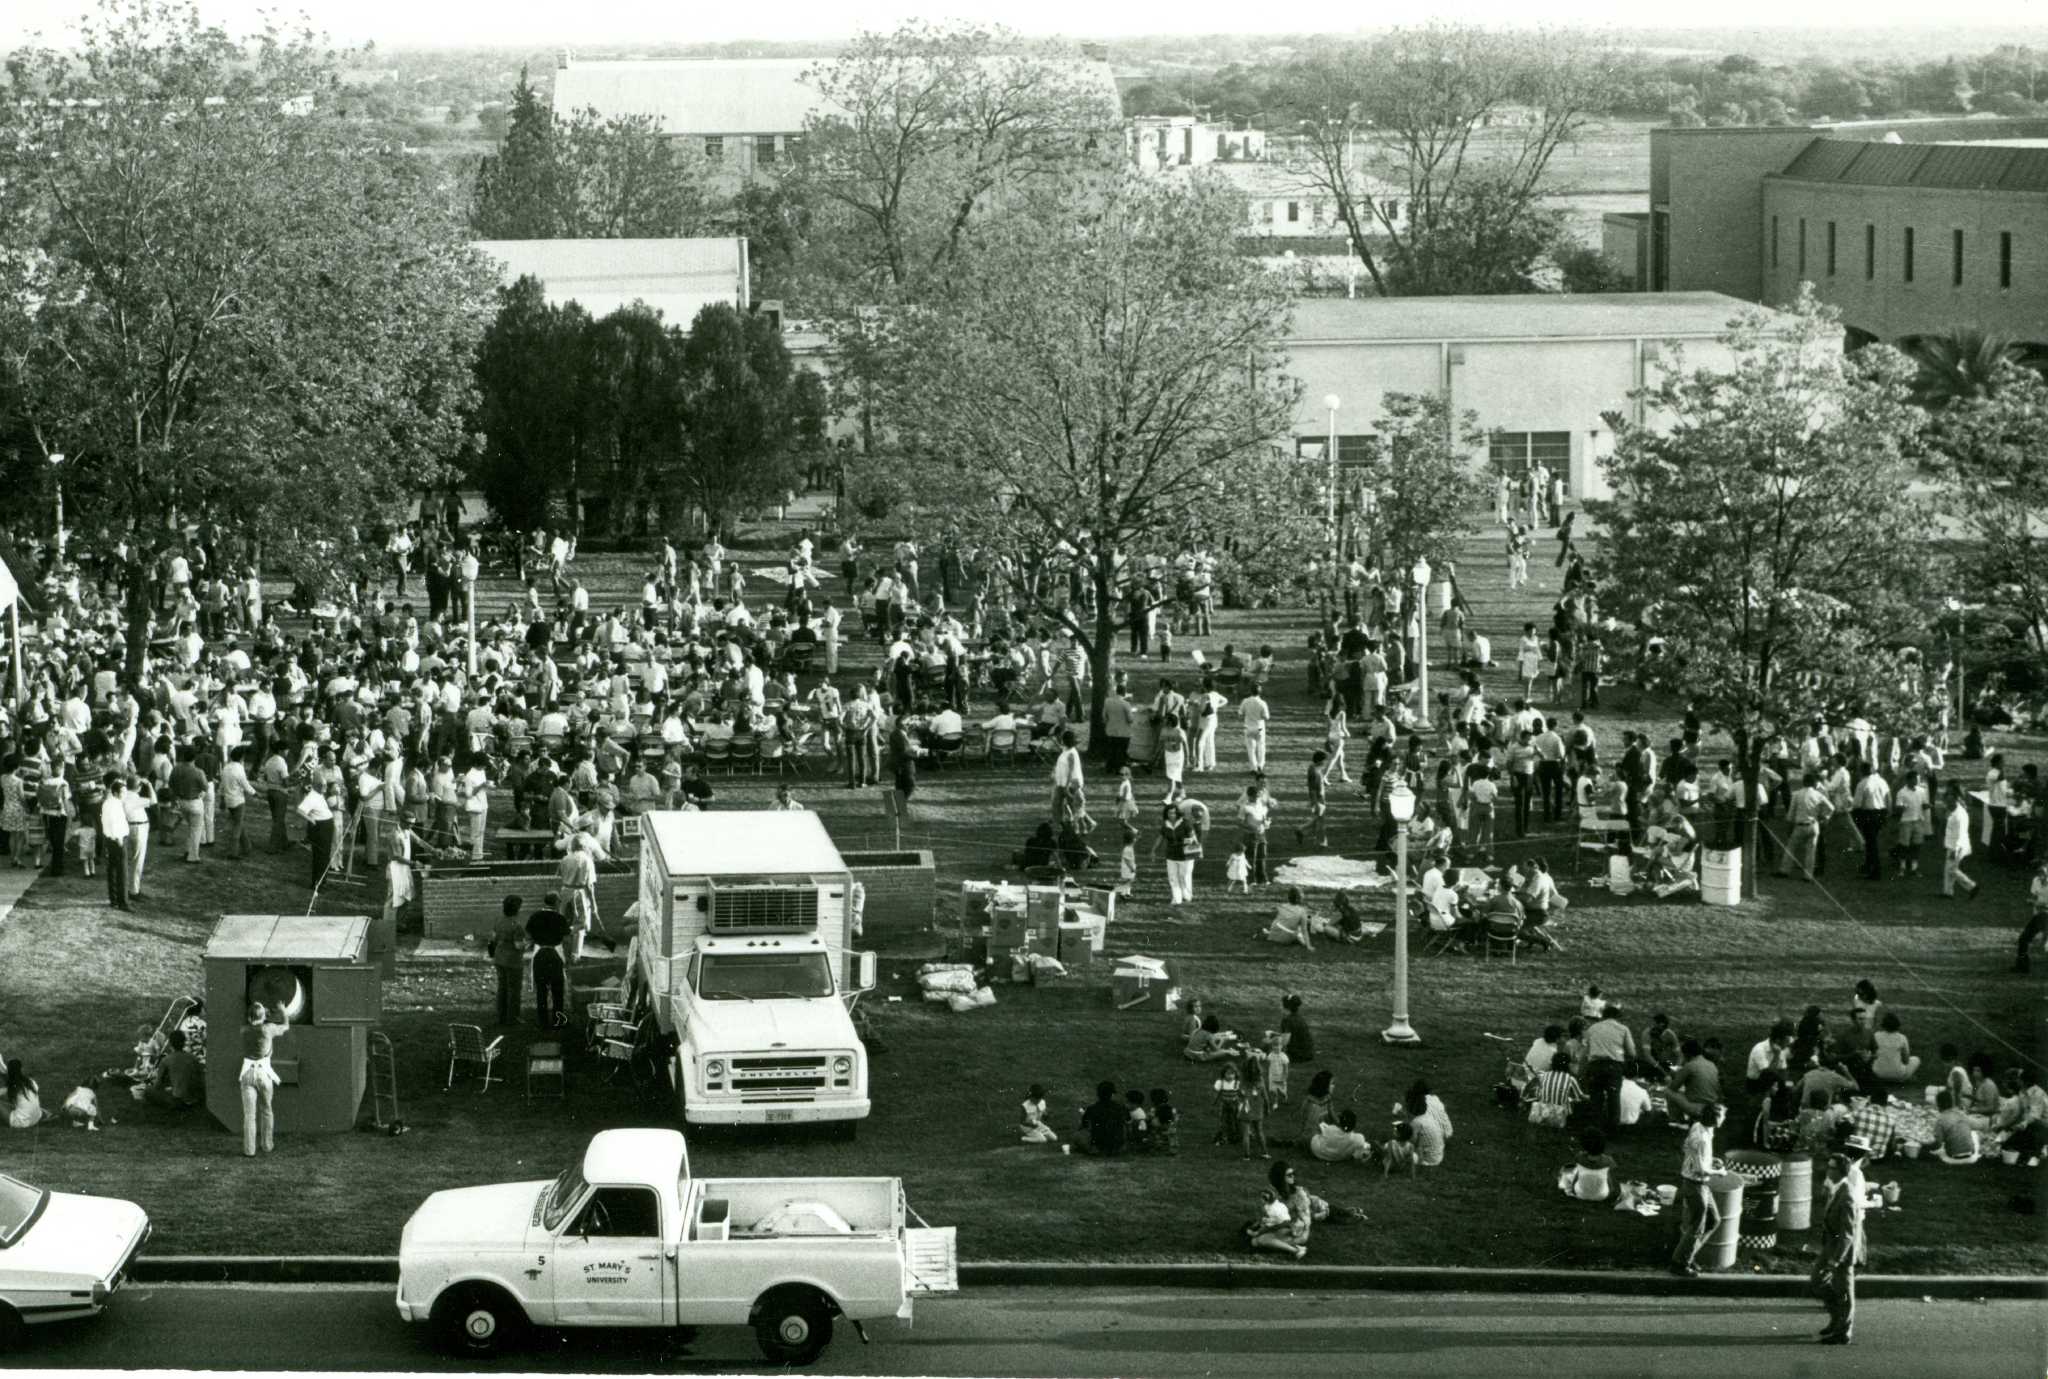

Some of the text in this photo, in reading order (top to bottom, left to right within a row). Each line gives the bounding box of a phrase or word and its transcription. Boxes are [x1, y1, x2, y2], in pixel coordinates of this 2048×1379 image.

[538, 1255, 546, 1266] 5
[583, 1259, 632, 1274] ST MARY'S
[586, 1276, 629, 1284] UNIVERSITY
